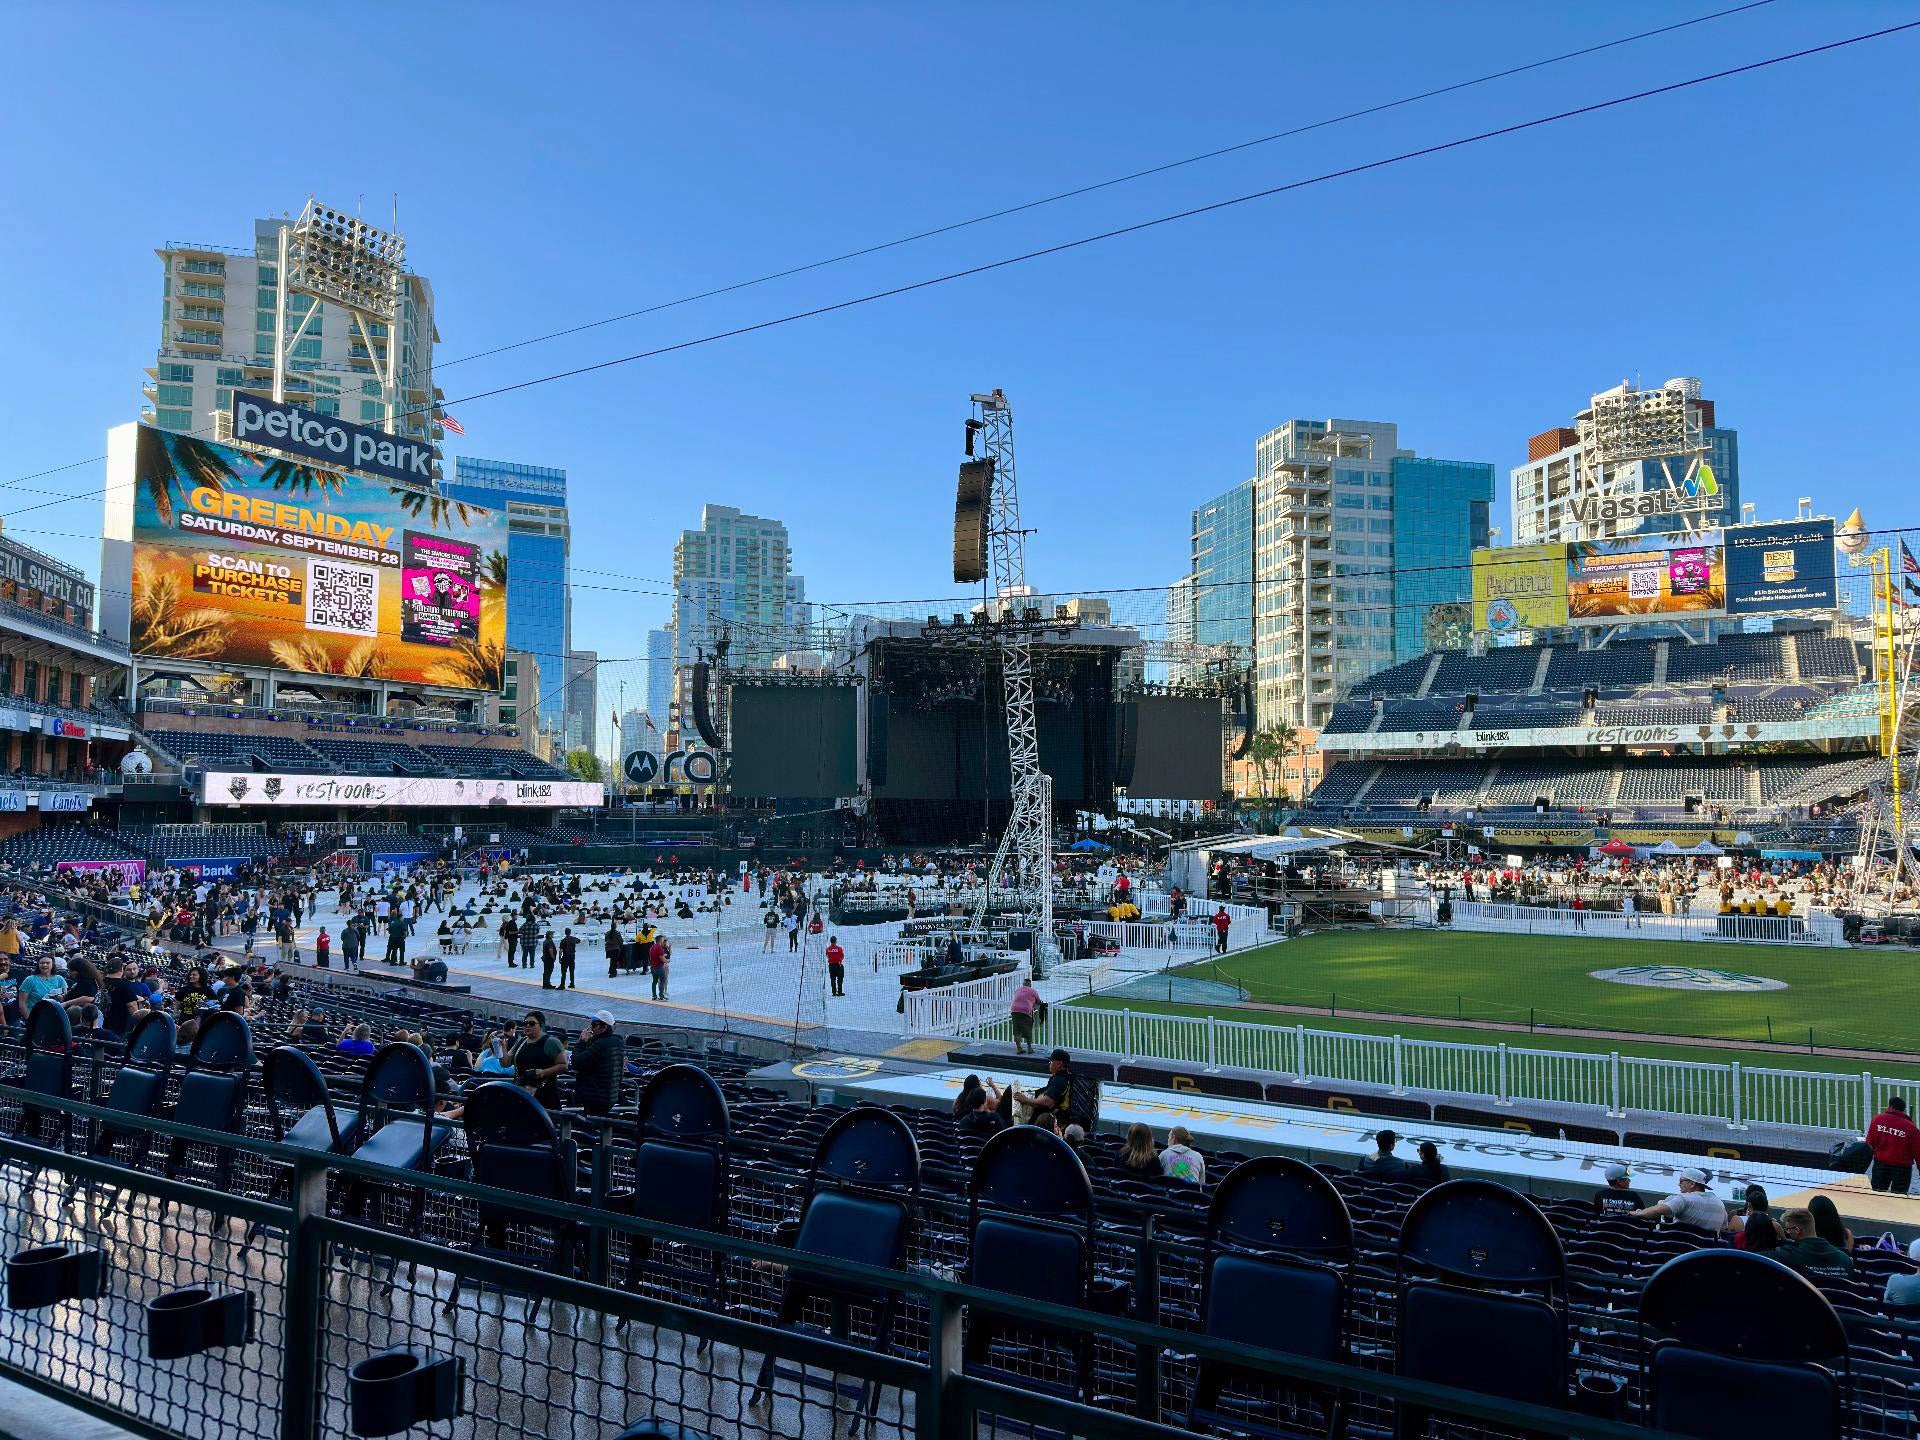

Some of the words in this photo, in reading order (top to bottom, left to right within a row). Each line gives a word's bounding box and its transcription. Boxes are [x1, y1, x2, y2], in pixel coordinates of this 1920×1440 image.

[237, 401, 348, 453] petco
[353, 433, 431, 476] park
[1569, 489, 1673, 521] Viasat
[191, 486, 395, 549] GREENDAY
[181, 513, 280, 544] SATURDAY,
[281, 533, 379, 562] SEPTEMBER
[380, 552, 399, 565] 28
[207, 554, 263, 574] SCAN
[265, 564, 291, 578] TO
[1765, 552, 1792, 560] BEST
[30, 564, 72, 602] SUPPLY
[76, 585, 92, 610] CO.
[196, 564, 302, 593] PURCHASE
[208, 581, 289, 605] TICKETS
[1586, 727, 1679, 744] restrooms
[296, 780, 387, 801] restrooms
[1351, 827, 1397, 835] CHROME
[202, 864, 233, 877] bank
[1877, 1124, 1906, 1138] ELITE
